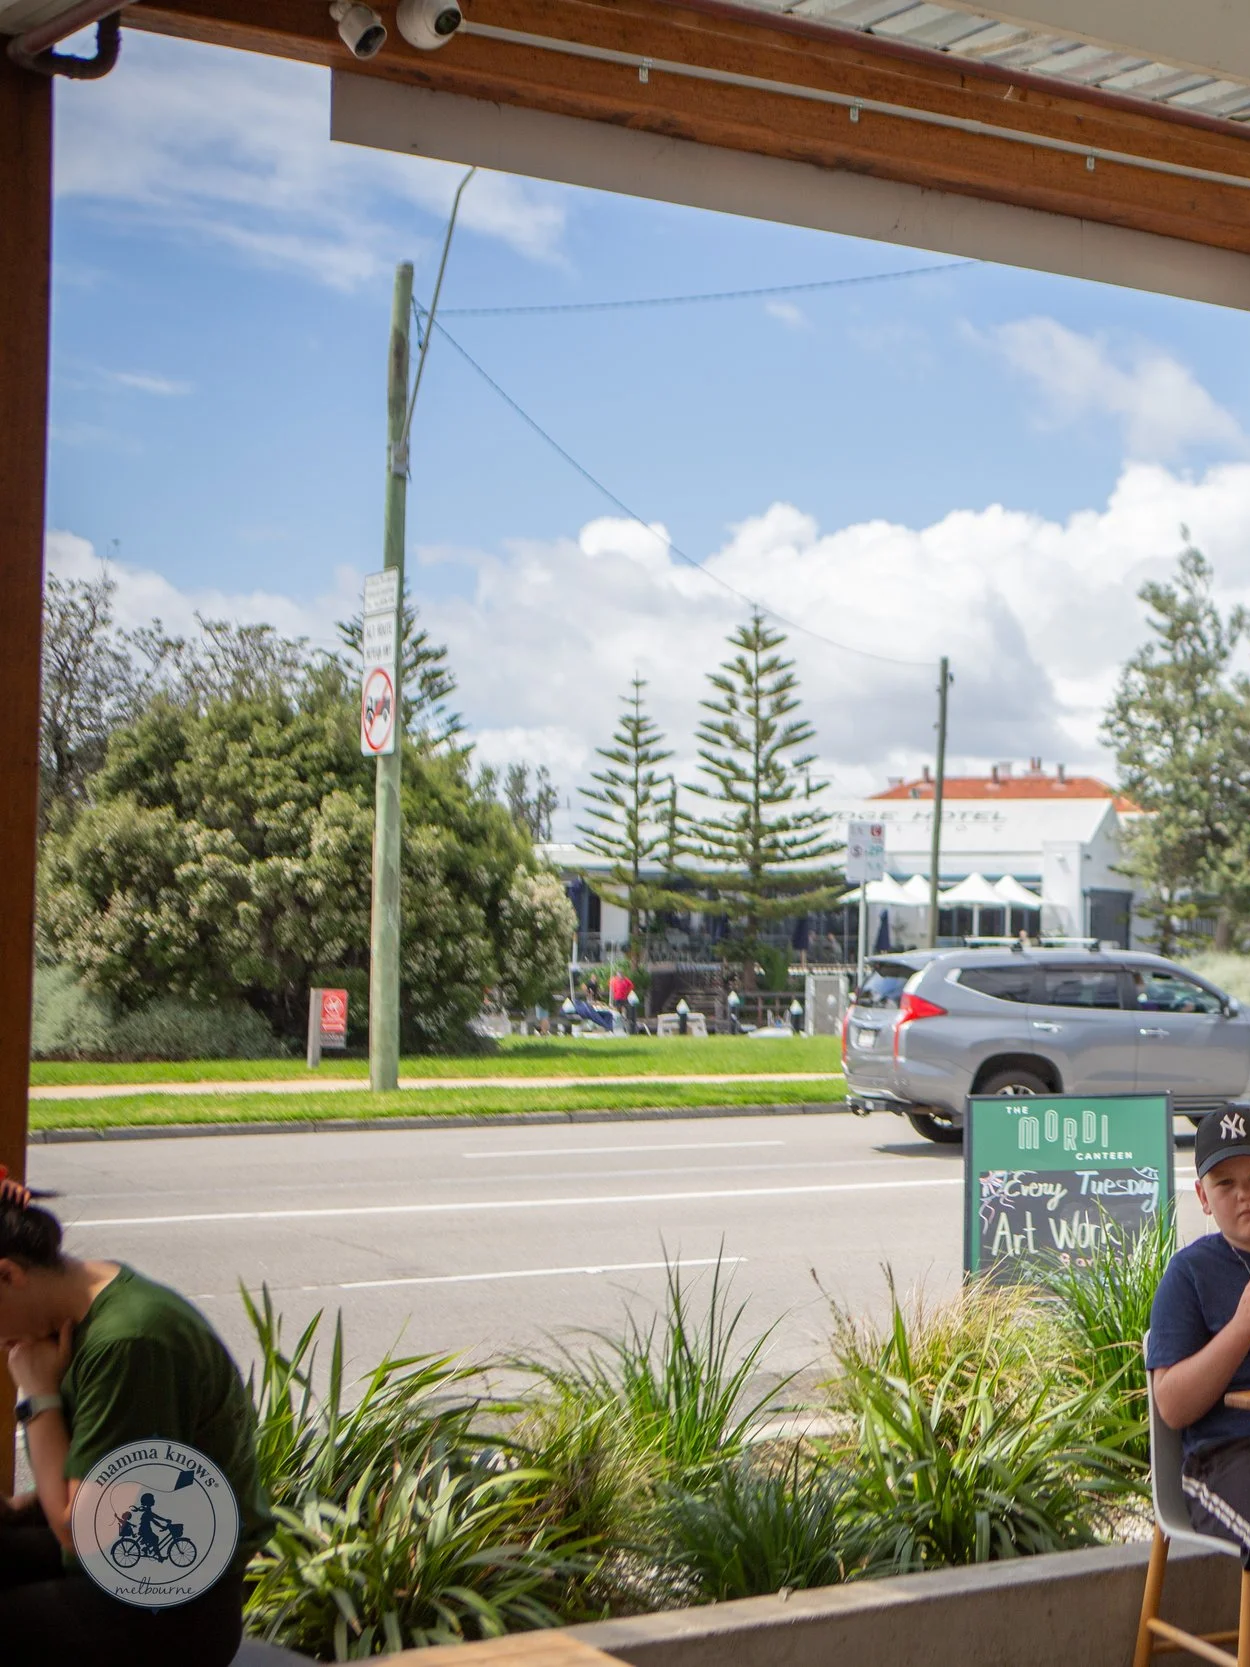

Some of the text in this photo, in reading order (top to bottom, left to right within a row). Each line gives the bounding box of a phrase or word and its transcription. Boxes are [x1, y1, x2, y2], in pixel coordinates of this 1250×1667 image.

[1006, 1105, 1029, 1115] THE
[1018, 1109, 1109, 1151] MORDI
[1075, 1151, 1133, 1161] CANTEEN
[1004, 1170, 1068, 1211] Every
[991, 1211, 1038, 1257] Art
